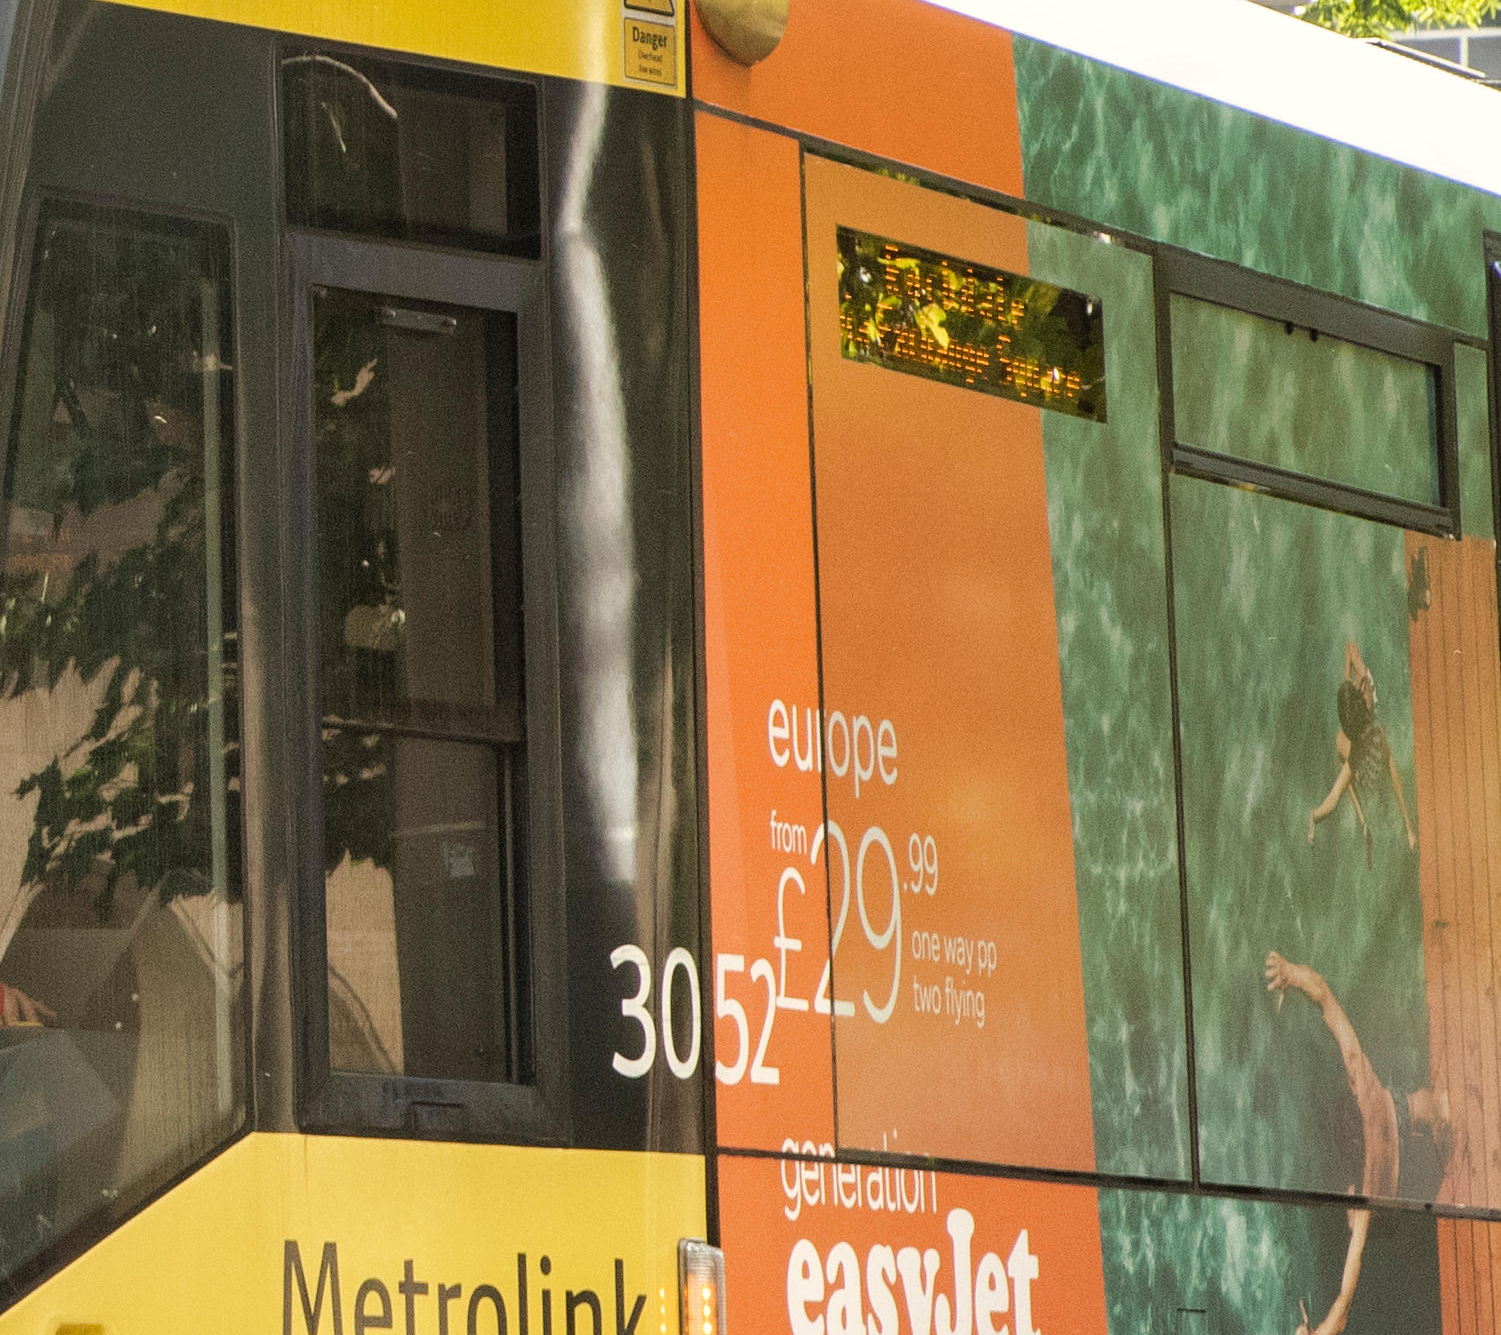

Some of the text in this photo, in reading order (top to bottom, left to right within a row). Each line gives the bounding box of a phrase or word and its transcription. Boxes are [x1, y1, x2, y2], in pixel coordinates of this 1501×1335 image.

[632, 26, 668, 51] Danger
[768, 698, 898, 798] europe
[769, 809, 808, 854] from
[911, 930, 998, 978] one way pp
[609, 943, 780, 1086] 3052
[913, 976, 986, 1028] two flying
[782, 1131, 938, 1220] generation
